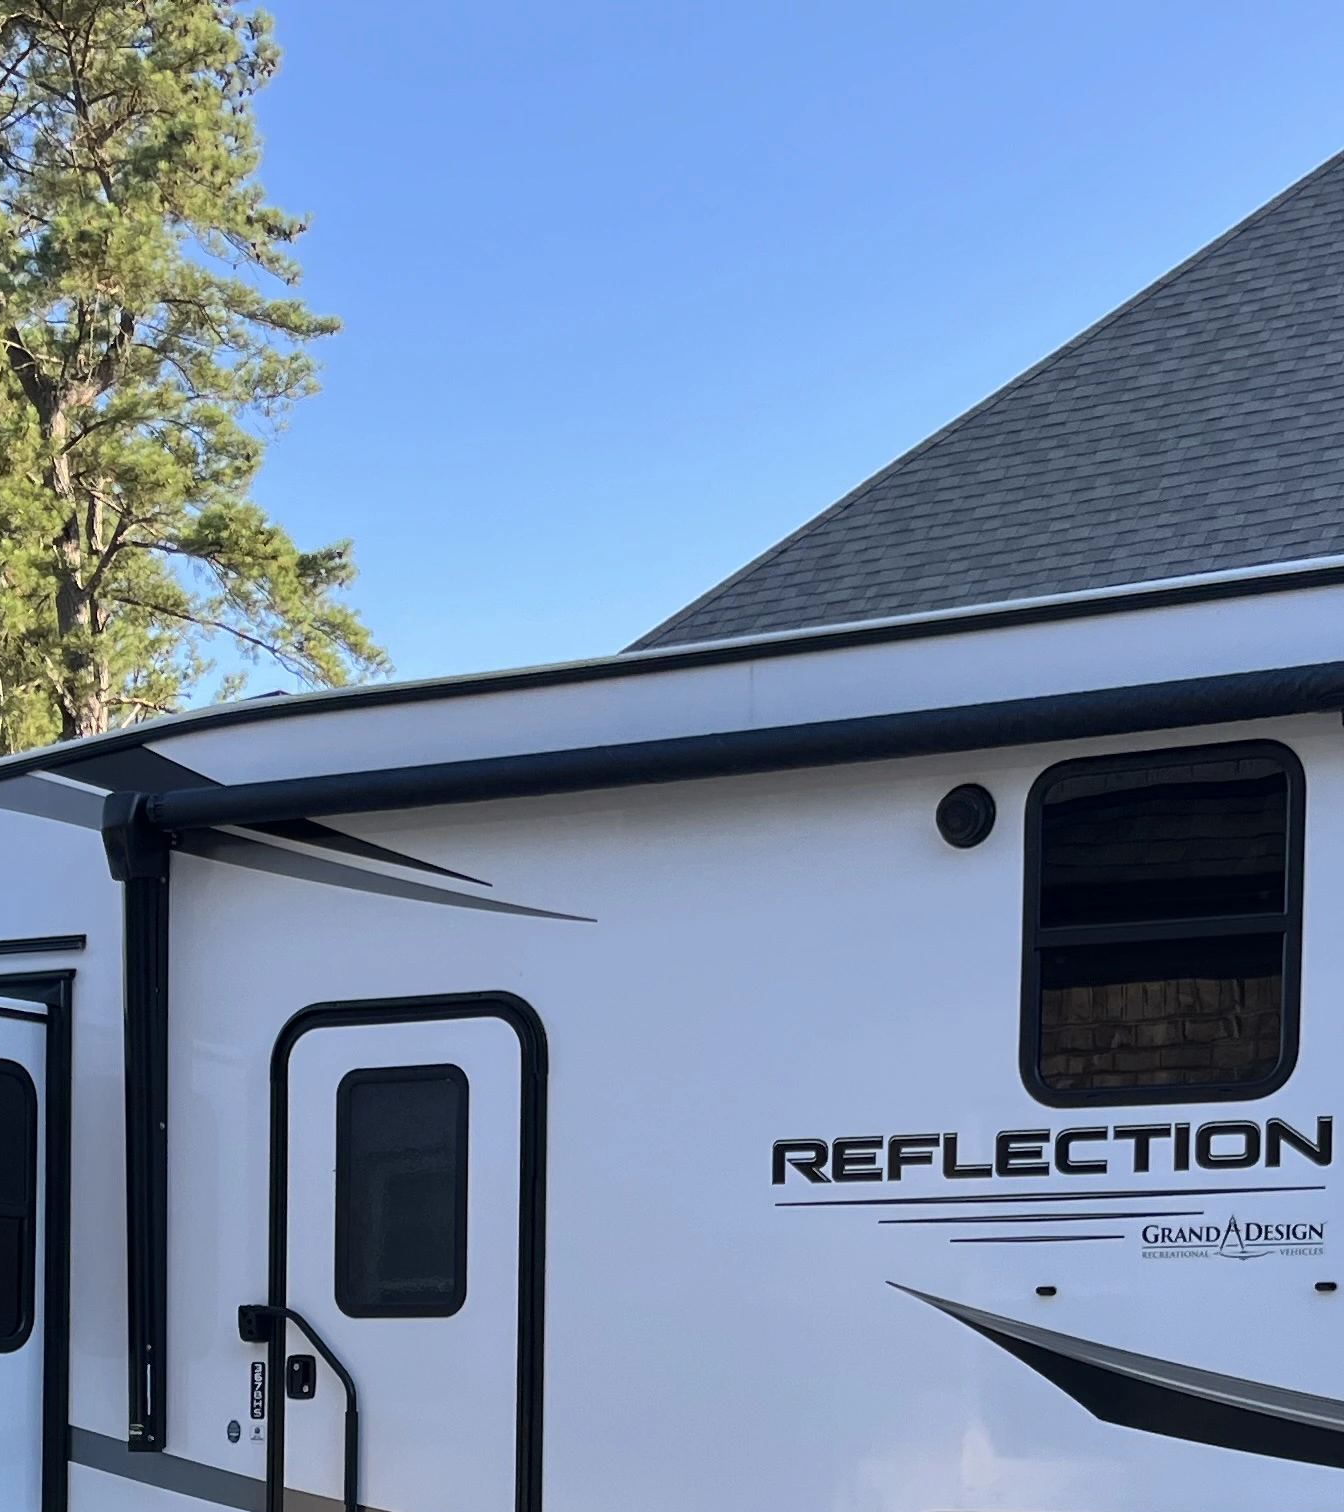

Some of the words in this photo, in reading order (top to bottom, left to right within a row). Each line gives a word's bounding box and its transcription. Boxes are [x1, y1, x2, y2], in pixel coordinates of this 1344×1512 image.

[771, 1115, 1334, 1185] REFLECTION
[1142, 1250, 1209, 1259] RECREATIONAL
[1279, 1247, 1324, 1257] VEHICLES
